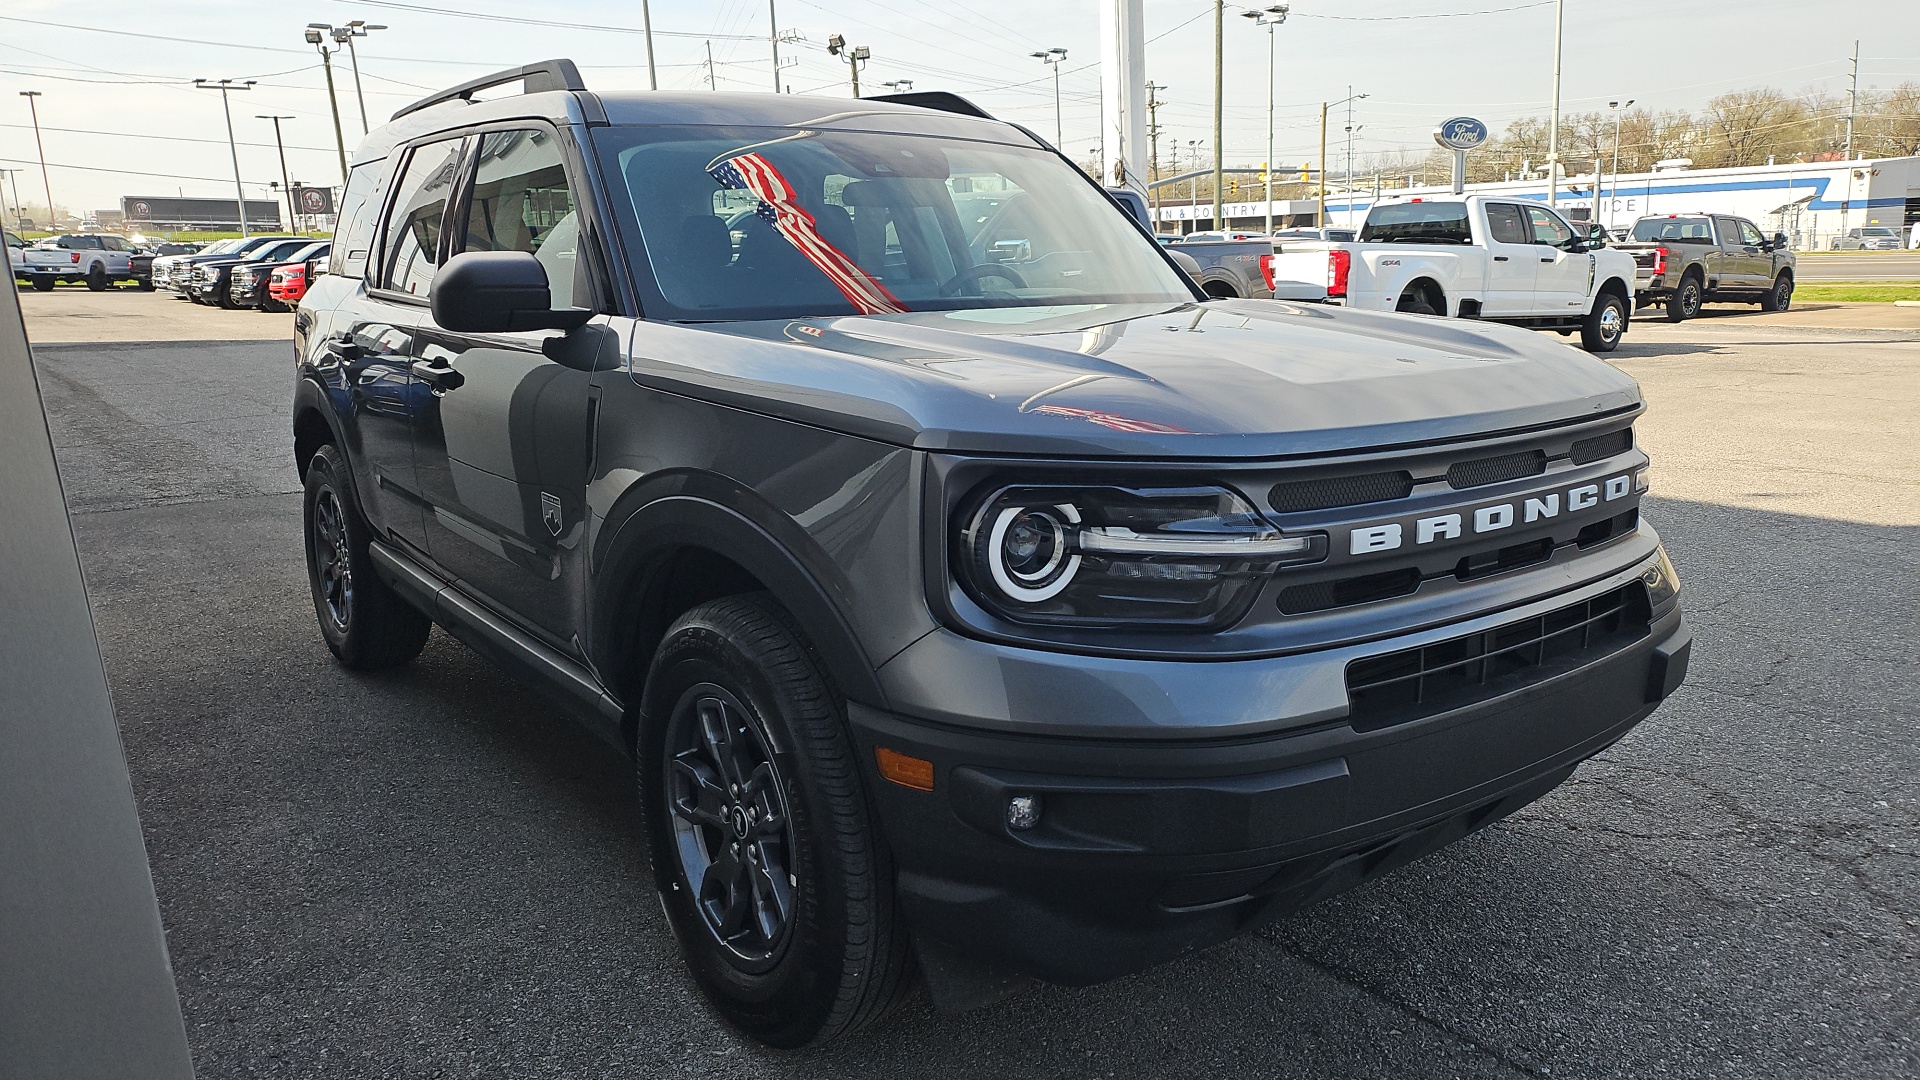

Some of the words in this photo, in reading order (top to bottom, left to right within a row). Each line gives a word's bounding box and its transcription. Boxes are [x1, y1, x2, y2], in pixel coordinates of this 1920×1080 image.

[1451, 122, 1480, 142] Ford
[1180, 208, 1186, 219] &
[1194, 204, 1257, 219] CONTRY
[1555, 199, 1636, 213] RICE
[1350, 475, 1630, 556] BRONCO
